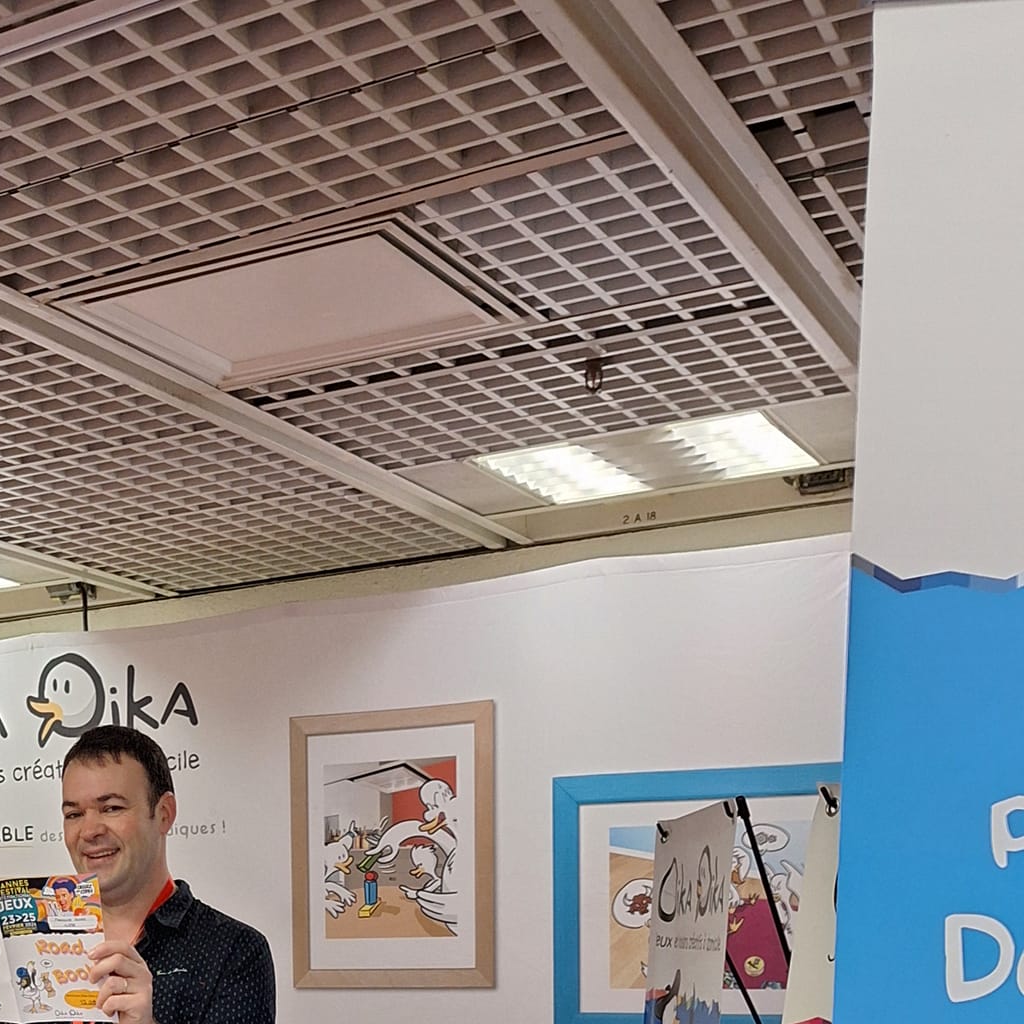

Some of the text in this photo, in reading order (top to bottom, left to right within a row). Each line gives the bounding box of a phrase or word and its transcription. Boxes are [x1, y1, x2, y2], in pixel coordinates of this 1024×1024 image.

[623, 511, 656, 524] 2 A 18
[13, 760, 63, 782] créat
[167, 750, 201, 772] cile
[1, 913, 36, 925] 23>25
